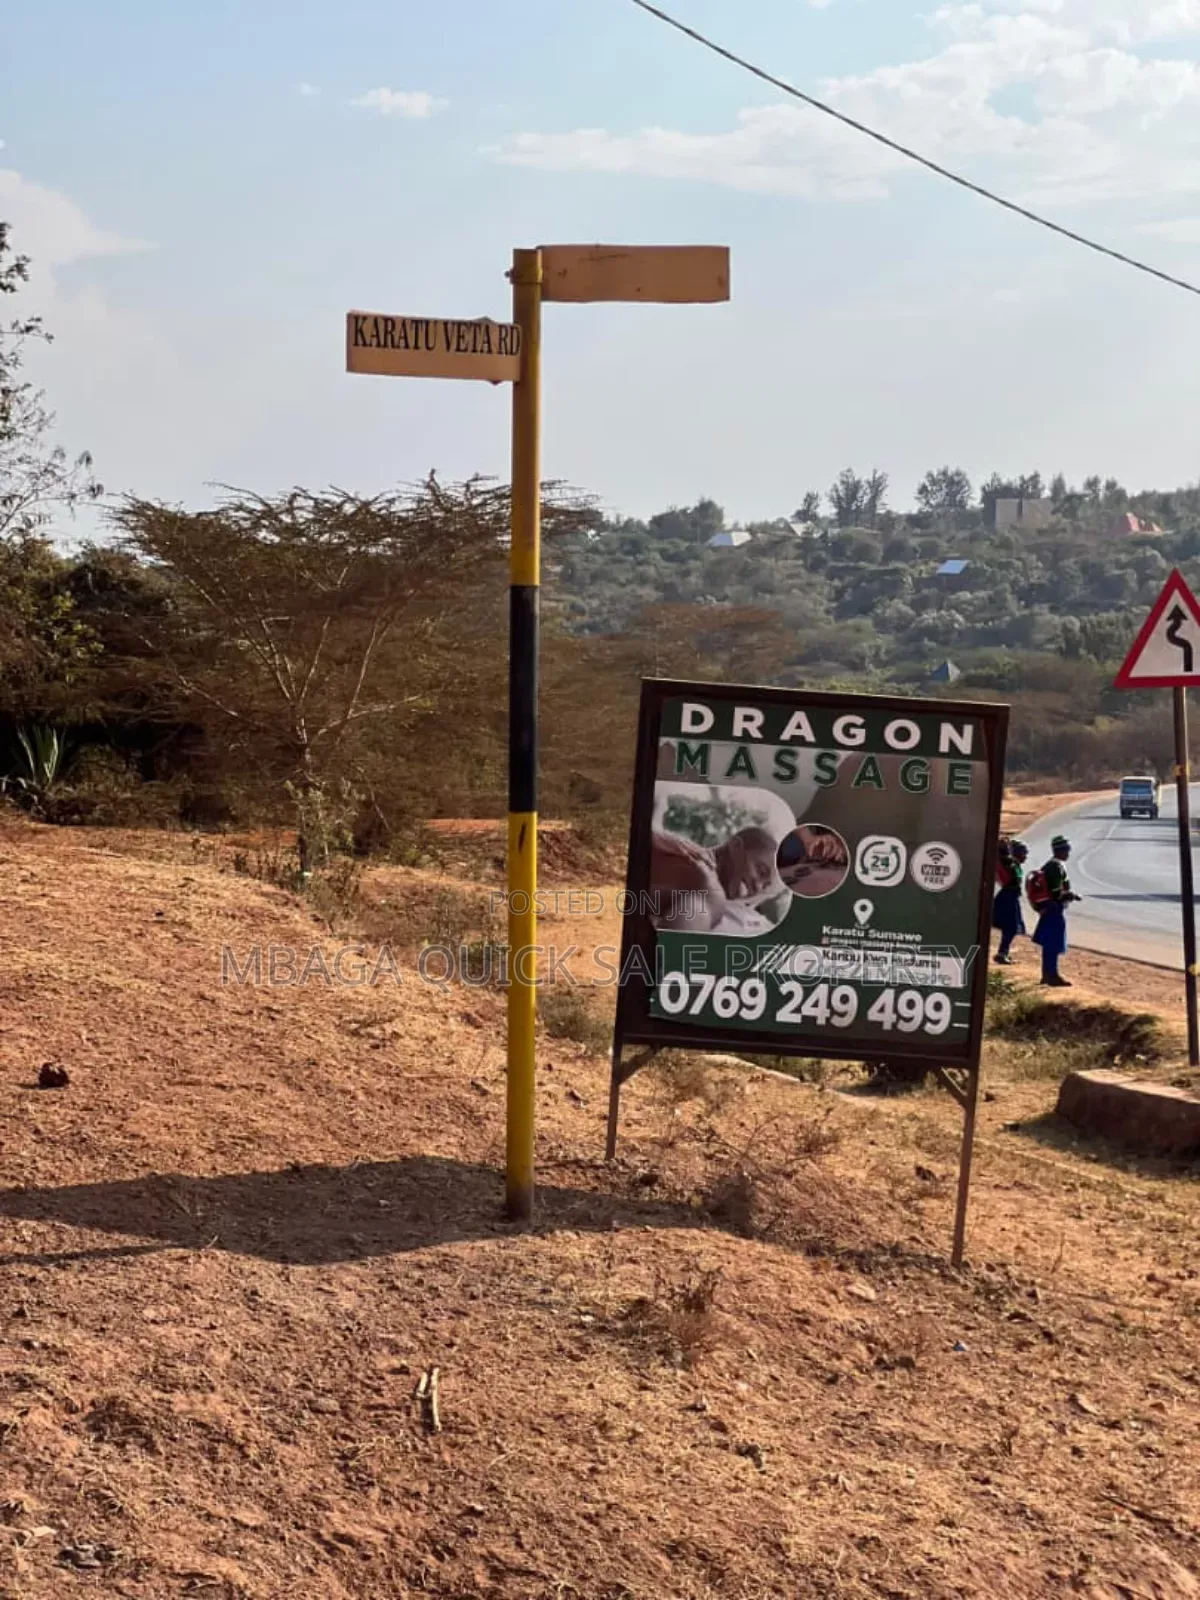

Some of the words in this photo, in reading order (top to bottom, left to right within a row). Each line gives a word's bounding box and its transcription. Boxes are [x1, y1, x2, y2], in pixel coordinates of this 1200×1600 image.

[352, 315, 436, 352] KARATU
[442, 320, 493, 355] VETA
[497, 324, 521, 357] RD
[680, 703, 974, 755] DRAGON
[675, 741, 973, 796] MASSAGE
[924, 877, 945, 885] FREE
[821, 925, 865, 937] Karatu
[867, 929, 922, 942] Sumawe
[659, 972, 767, 1021] 0769
[775, 983, 858, 1028] 249
[867, 989, 952, 1036] 499
